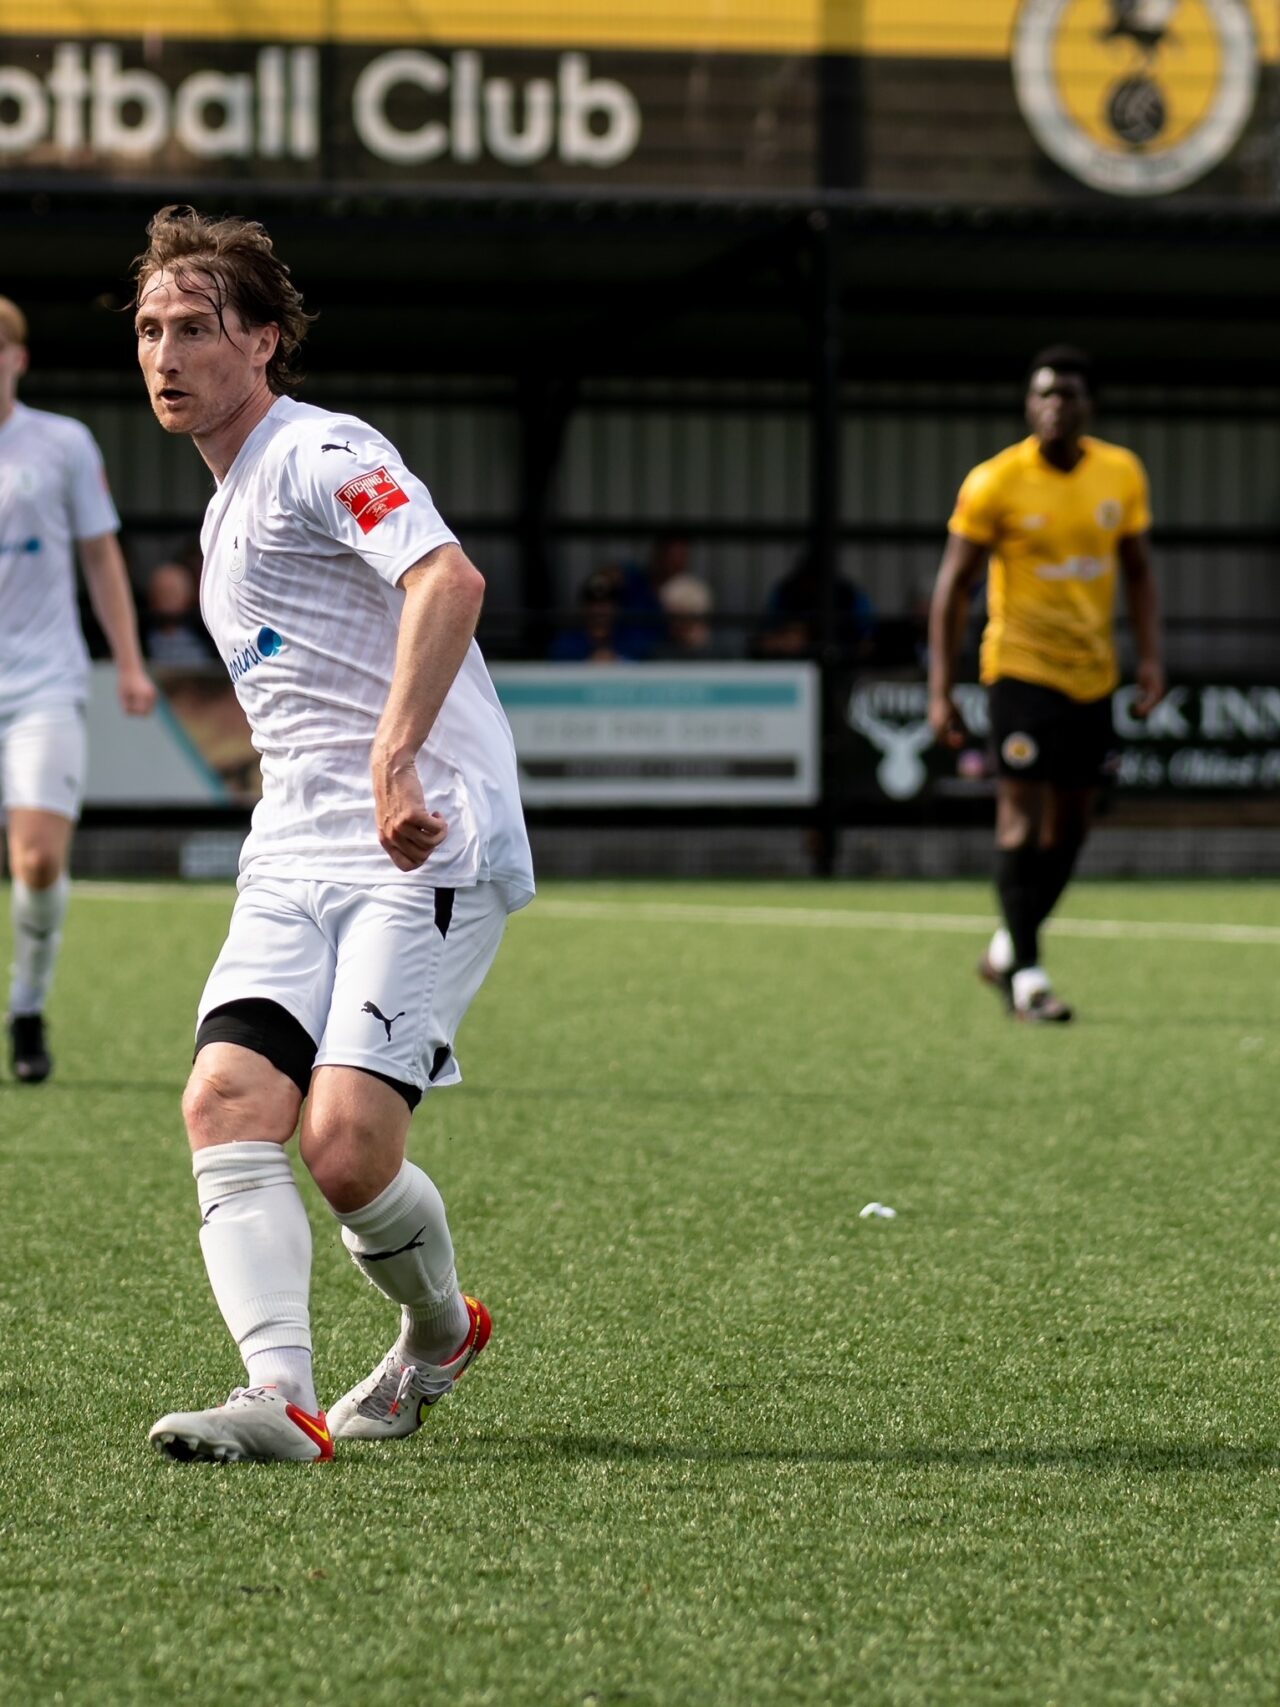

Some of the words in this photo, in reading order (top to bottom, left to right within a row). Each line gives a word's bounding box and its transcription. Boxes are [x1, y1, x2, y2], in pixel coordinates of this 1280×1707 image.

[354, 48, 639, 165] Club
[343, 474, 383, 502] PITCHING
[362, 484, 379, 499] IN
